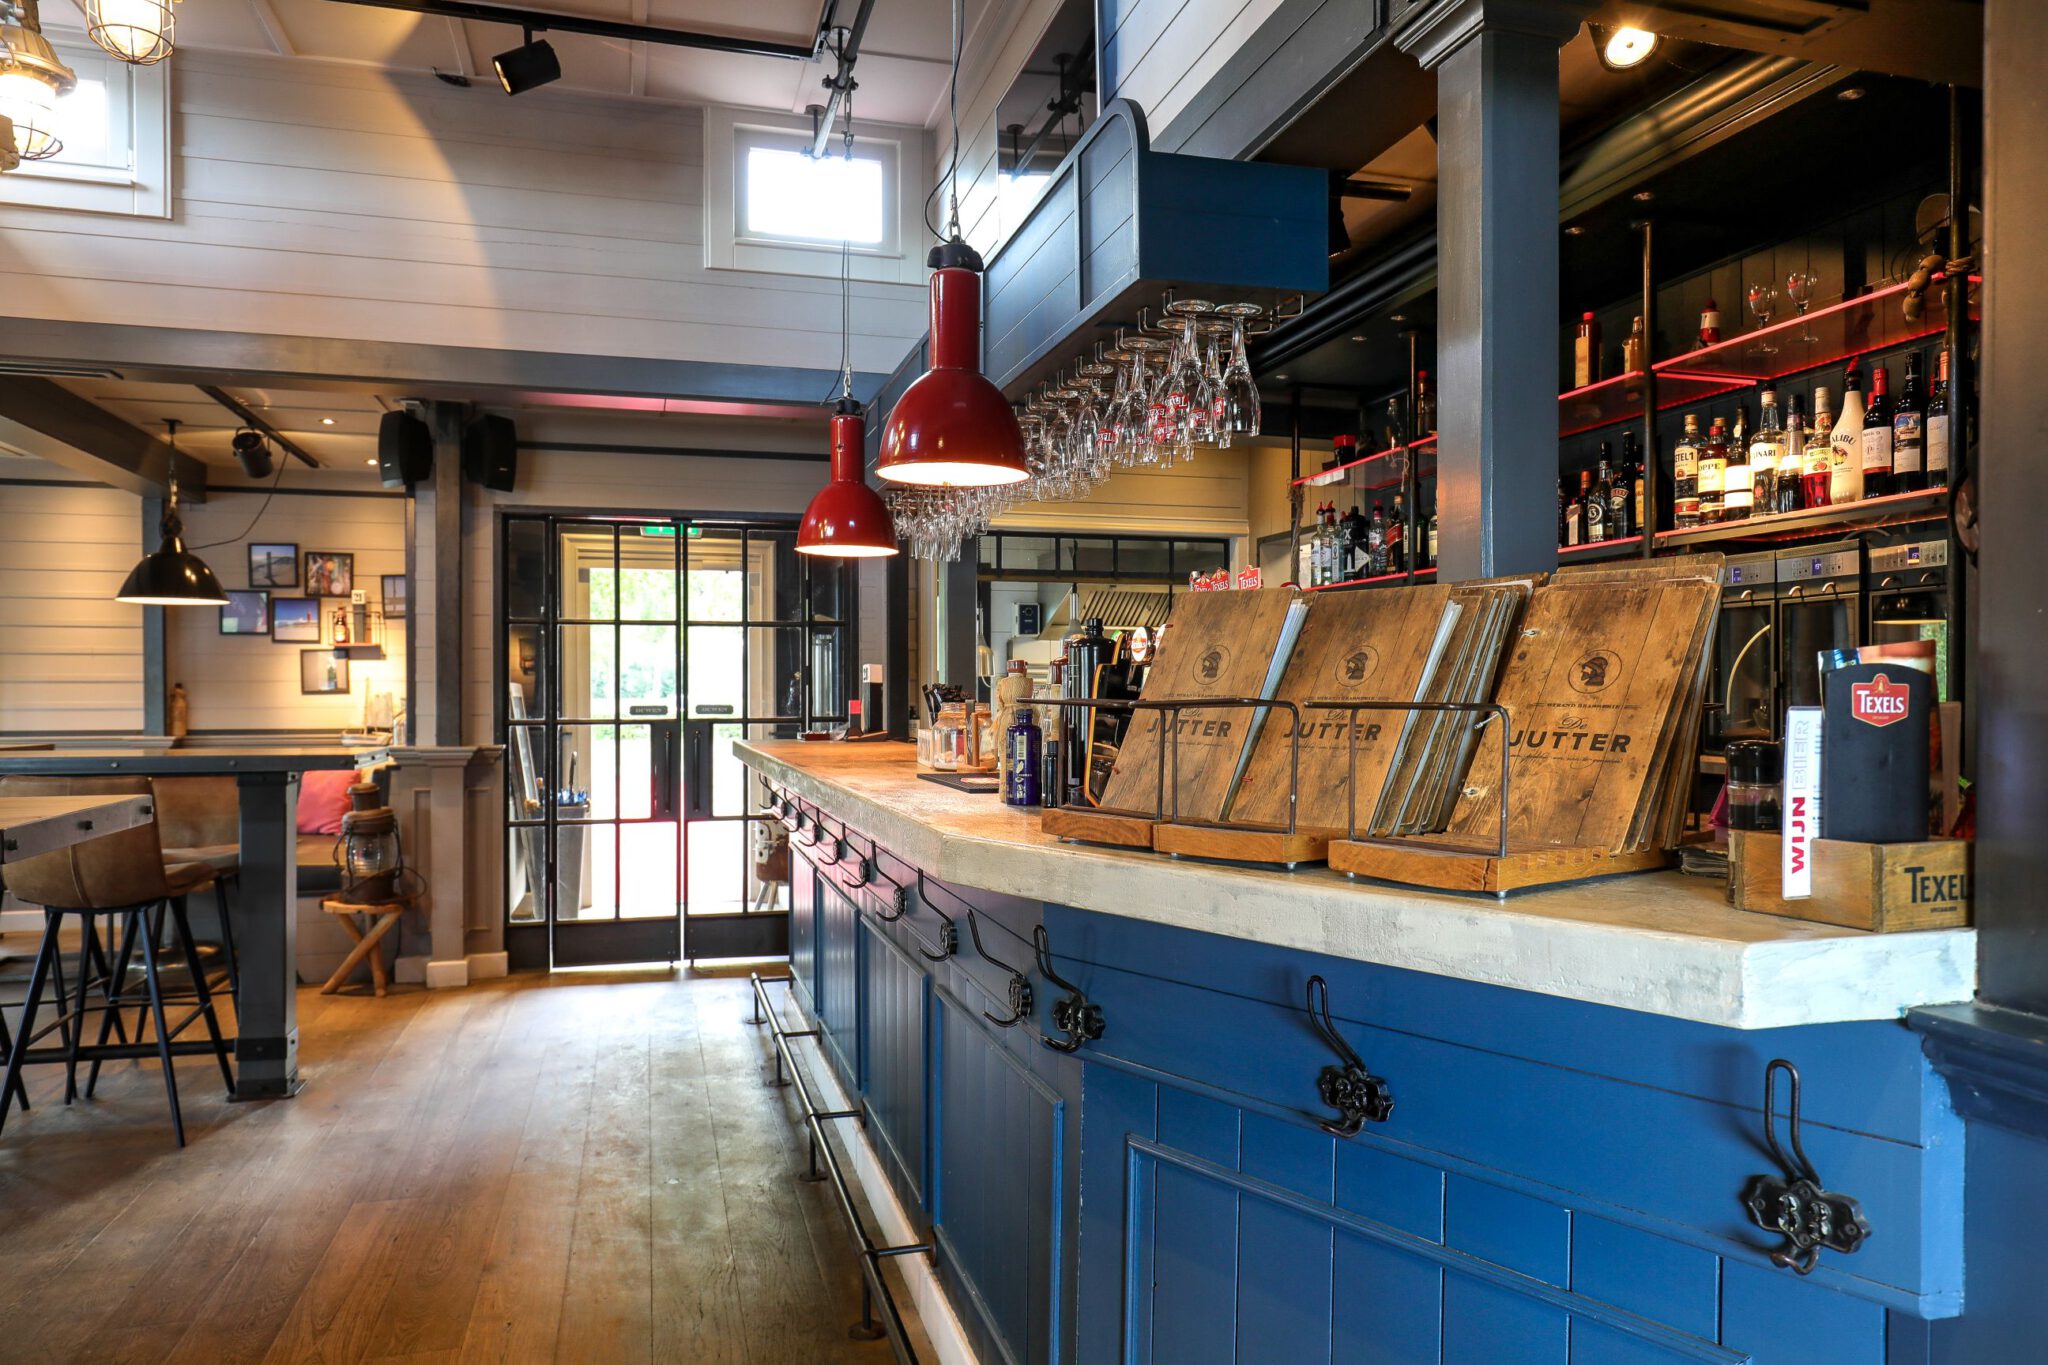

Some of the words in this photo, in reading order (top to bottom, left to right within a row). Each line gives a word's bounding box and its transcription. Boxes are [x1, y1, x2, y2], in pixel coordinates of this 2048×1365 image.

[1240, 576, 1258, 590] TEXELS
[1856, 690, 1905, 714] TEXELS
[1509, 730, 1632, 753] JUTTER
[1791, 719, 1810, 790] BIER
[1791, 797, 1806, 874] WIJN
